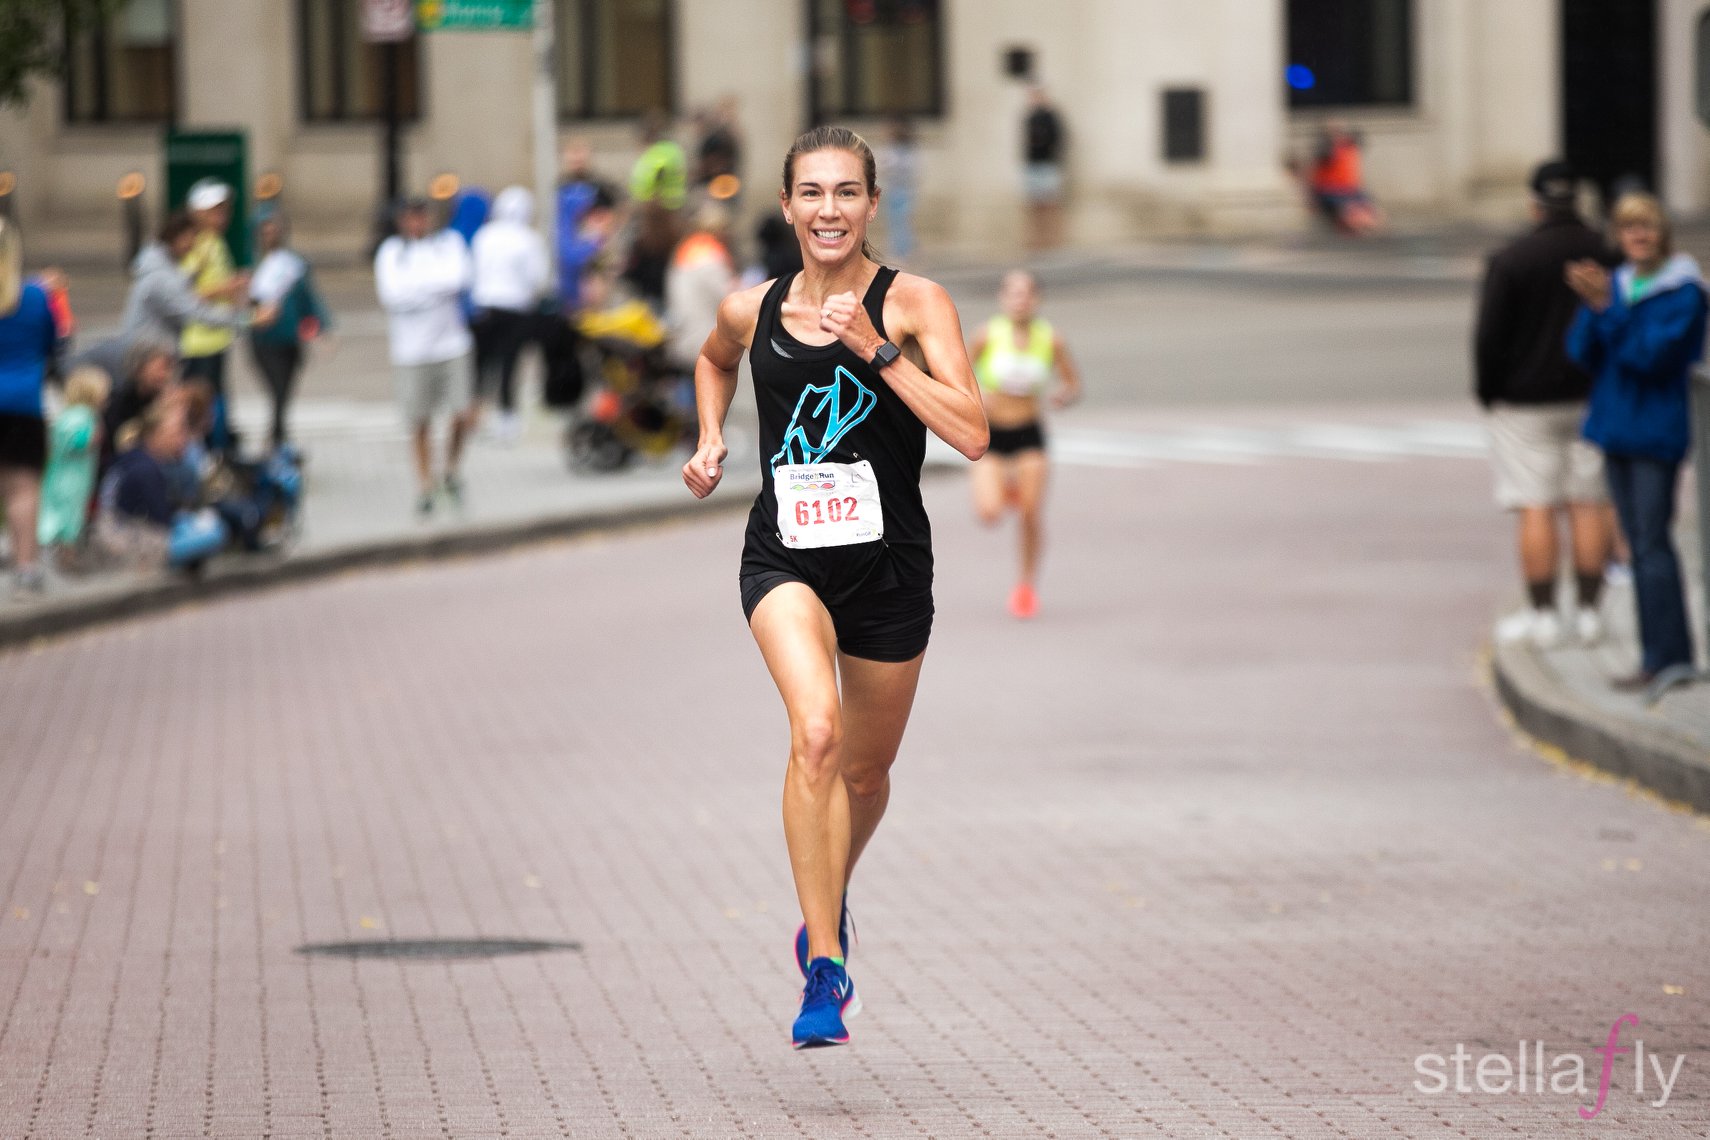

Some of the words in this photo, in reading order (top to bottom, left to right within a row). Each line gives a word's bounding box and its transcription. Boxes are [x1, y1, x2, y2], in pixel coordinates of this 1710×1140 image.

[790, 473, 814, 481] Bridge
[795, 496, 860, 526] 6102
[789, 535, 798, 543] 5K
